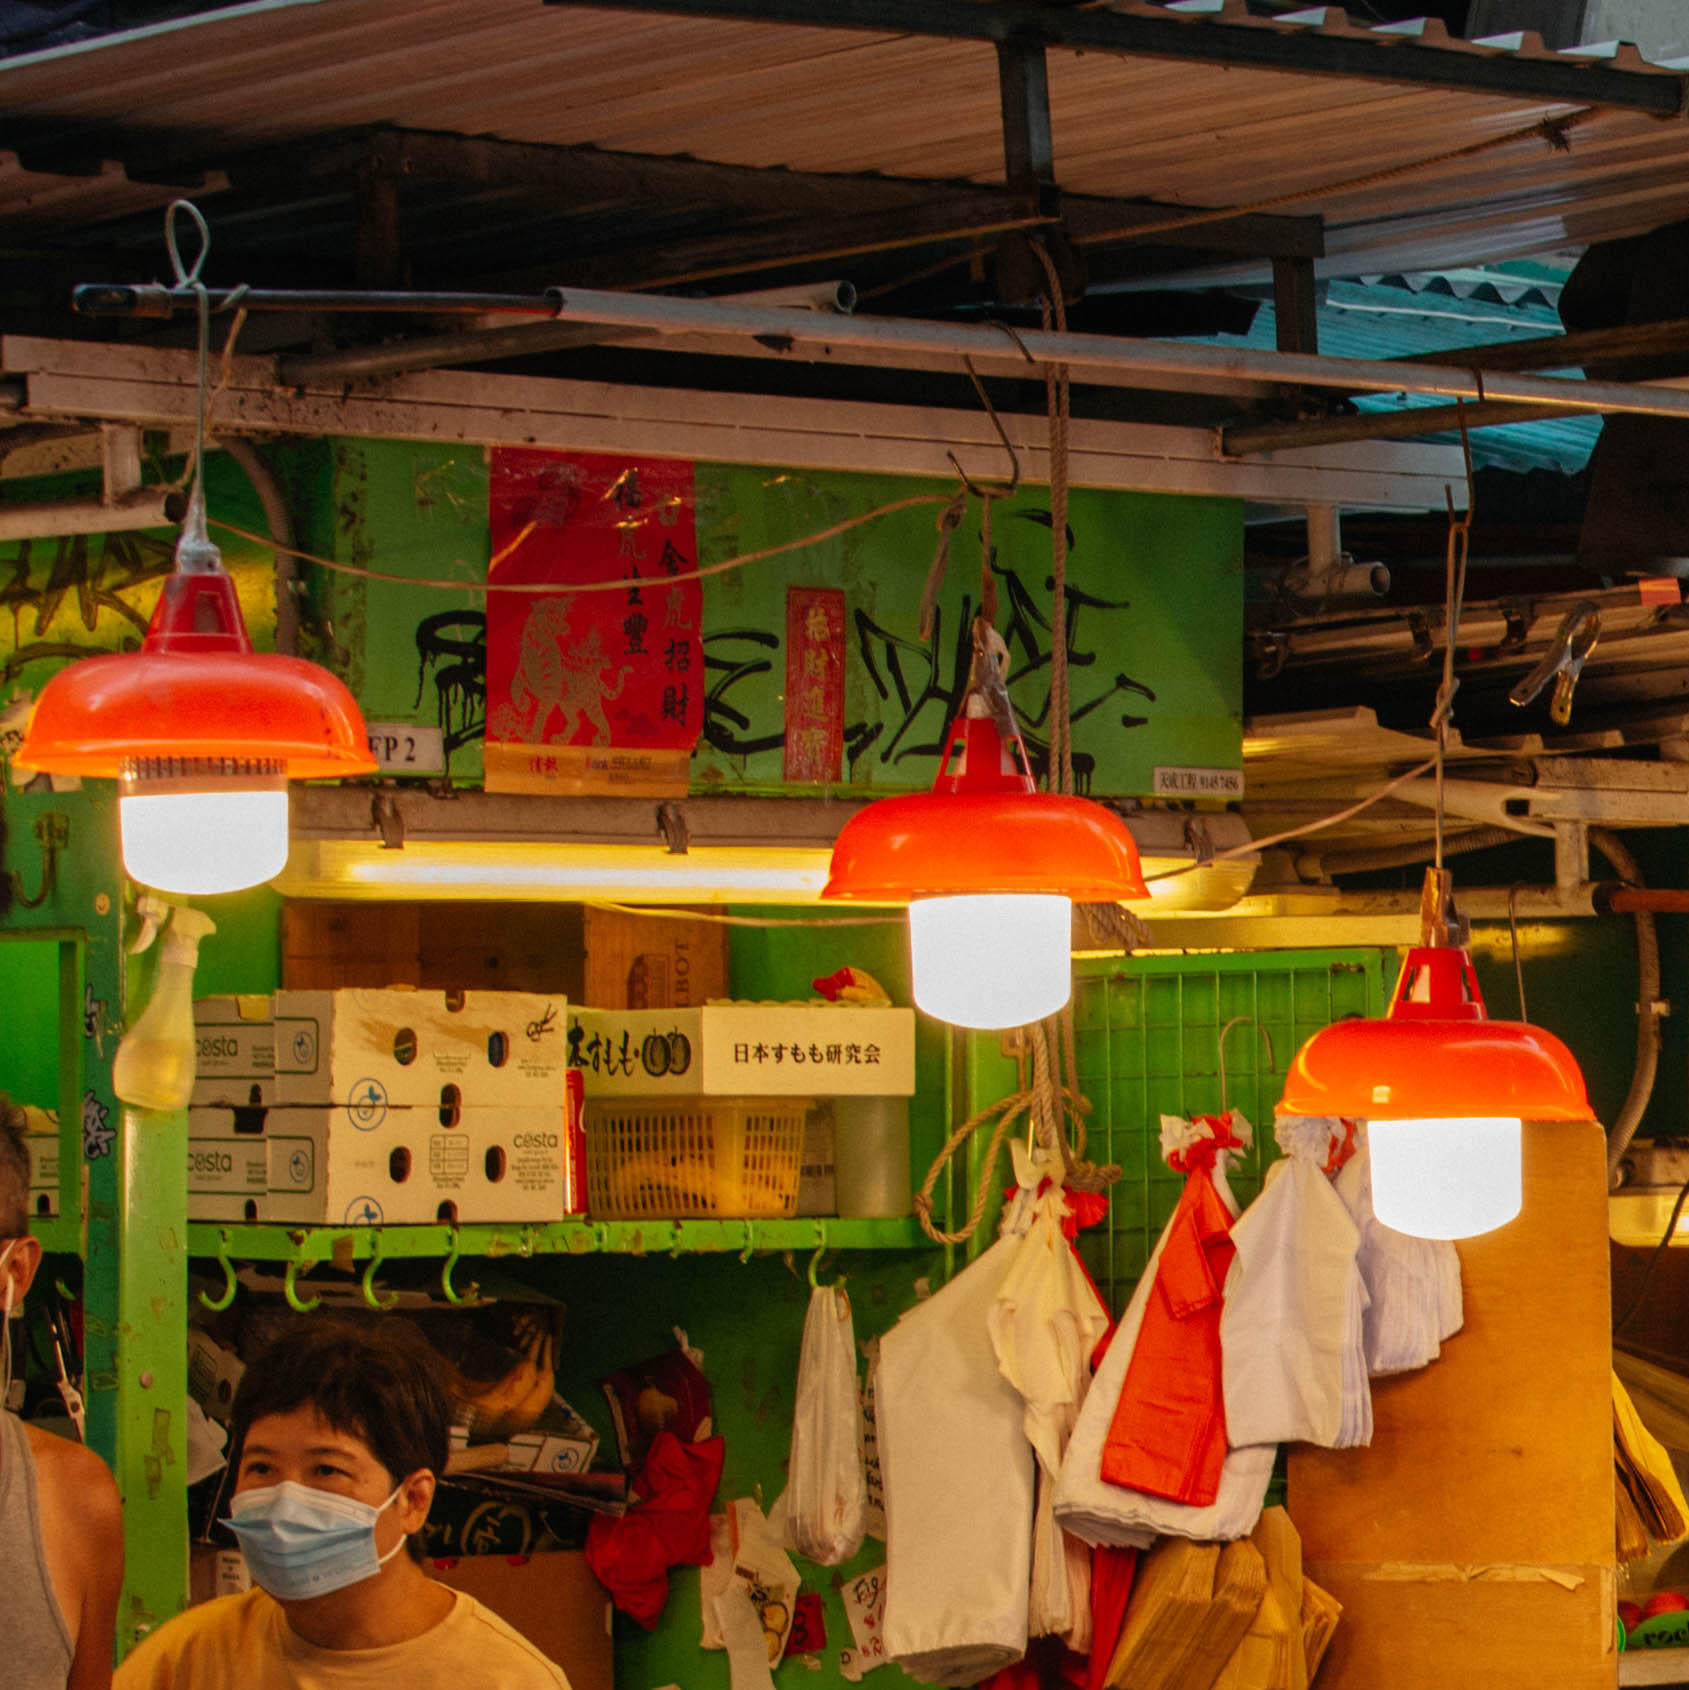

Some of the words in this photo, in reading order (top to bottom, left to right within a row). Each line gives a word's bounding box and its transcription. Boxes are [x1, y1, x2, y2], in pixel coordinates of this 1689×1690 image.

[404, 736, 416, 762] 2
[734, 1044, 881, 1064] 日本すもも研究会
